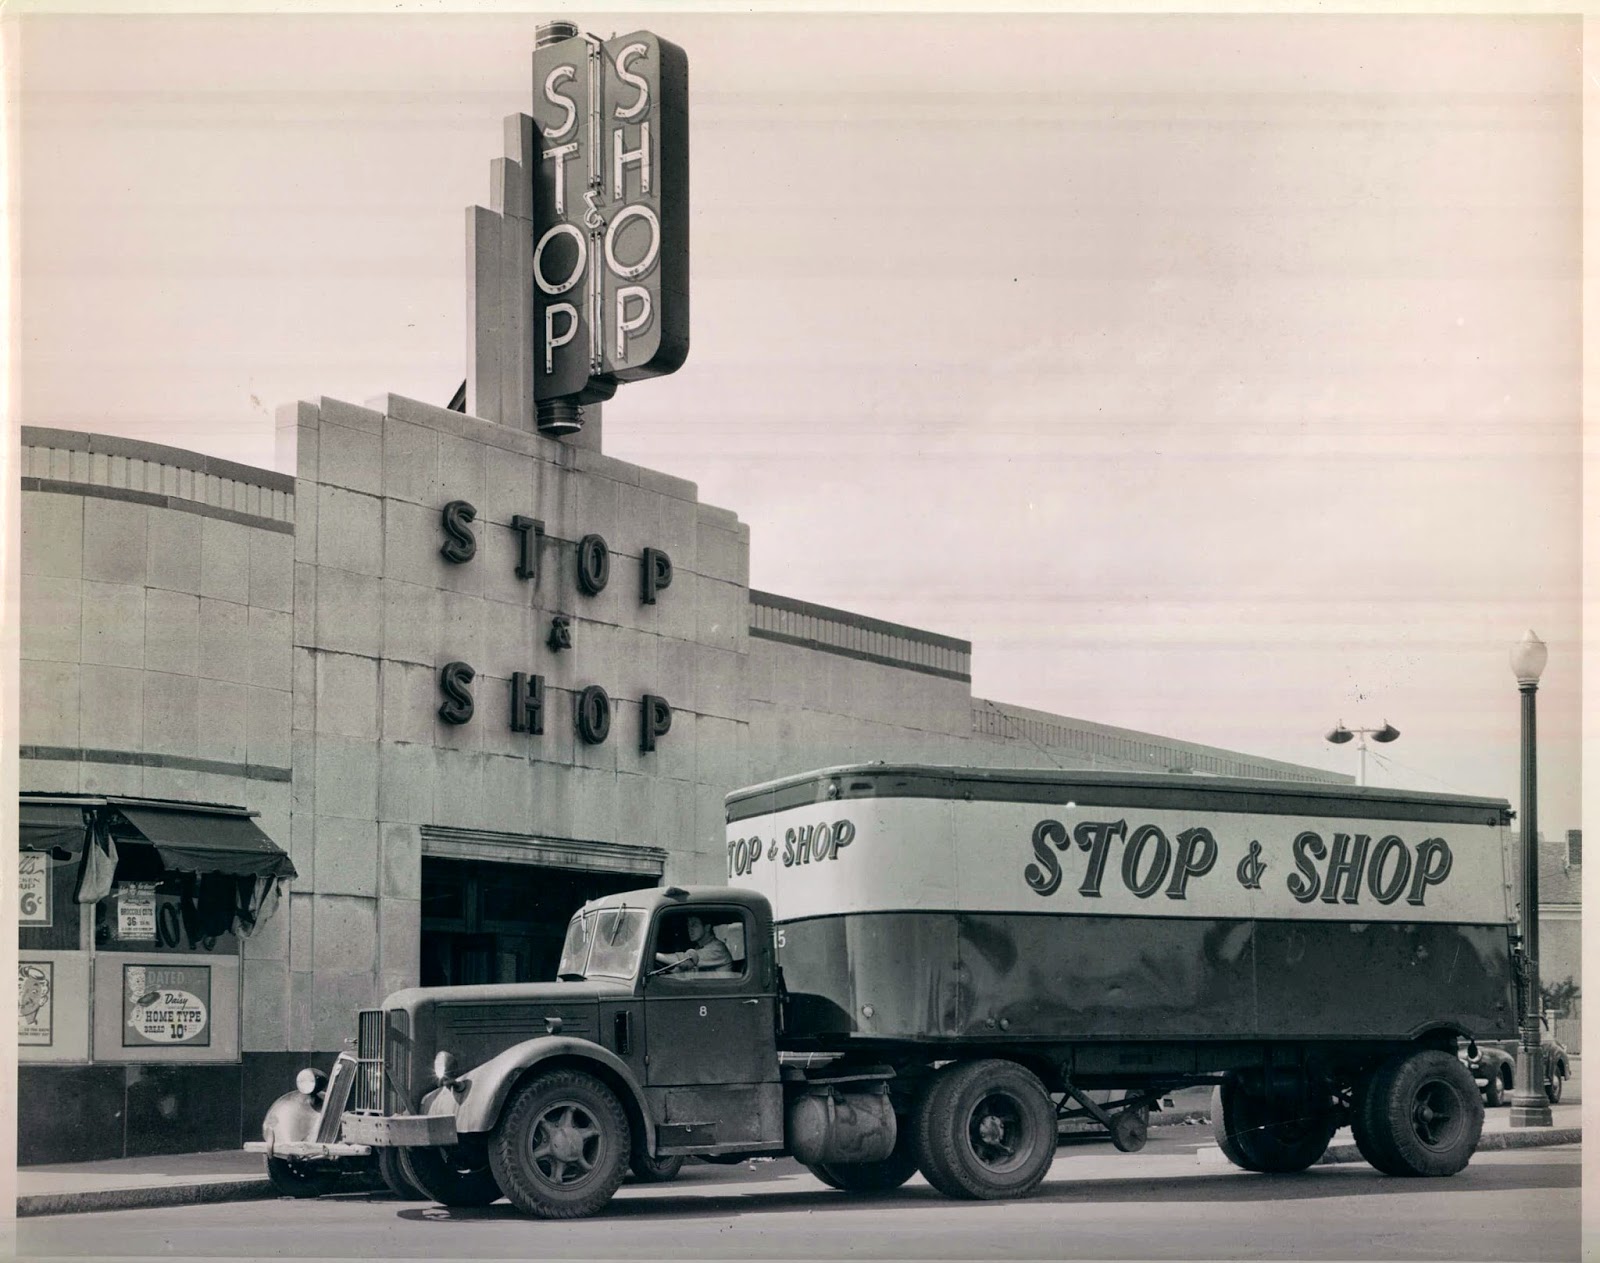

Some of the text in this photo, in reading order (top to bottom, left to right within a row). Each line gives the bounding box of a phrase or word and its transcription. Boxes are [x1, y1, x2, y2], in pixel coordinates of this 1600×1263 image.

[533, 65, 587, 373] STOP
[605, 43, 660, 359] SHOP
[440, 500, 673, 605] STOP
[548, 616, 572, 650] &
[438, 661, 672, 752] SHOP
[782, 819, 856, 867] SHOP
[1024, 819, 1453, 905] STOP & SHOP
[145, 1010, 202, 1022] HOME TYPE
[165, 993, 188, 1010] Daisy
[699, 1005, 708, 1017] 8
